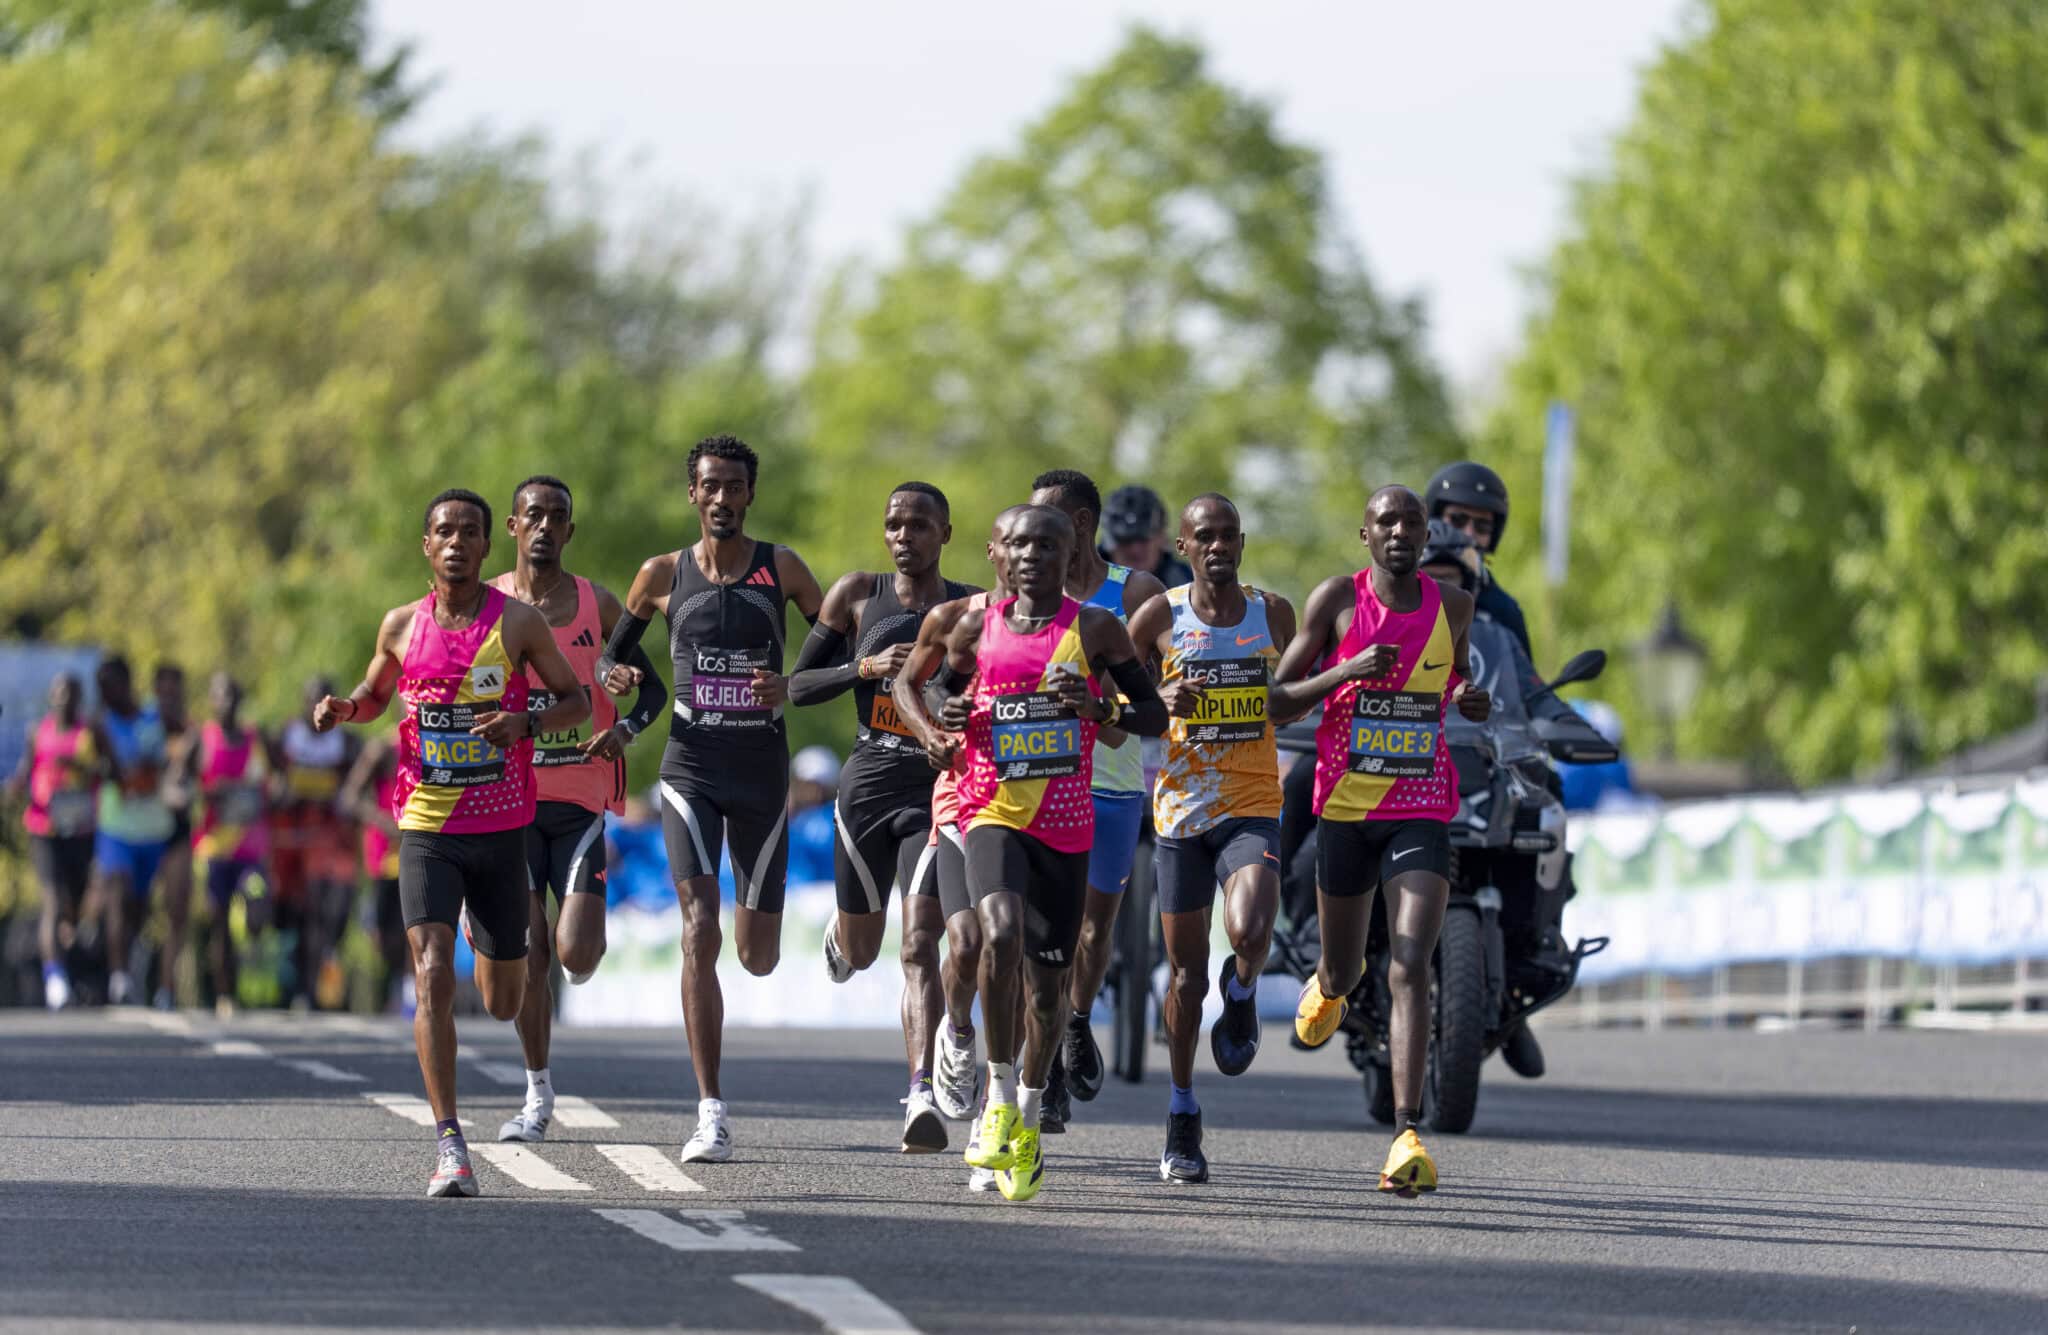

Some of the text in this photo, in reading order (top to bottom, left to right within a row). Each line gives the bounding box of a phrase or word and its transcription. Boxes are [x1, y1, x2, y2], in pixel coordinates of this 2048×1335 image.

[697, 651, 726, 672] tcs
[1220, 669, 1262, 677] CONSULTANCY
[996, 701, 1026, 720] tcs
[1359, 693, 1391, 716] tcs
[1393, 703, 1436, 711] CONSULTANCY
[420, 706, 450, 728] tcs
[1029, 710, 1059, 718] SERVICES
[738, 719, 766, 727] balance
[1235, 731, 1260, 739] balance
[1357, 727, 1433, 753] PACE 3
[999, 728, 1073, 757] PACE 1
[425, 740, 499, 764] PACE 2
[1045, 765, 1074, 775] balance
[1399, 767, 1427, 775] balance
[452, 777, 468, 785] new
[468, 773, 498, 784] balance
